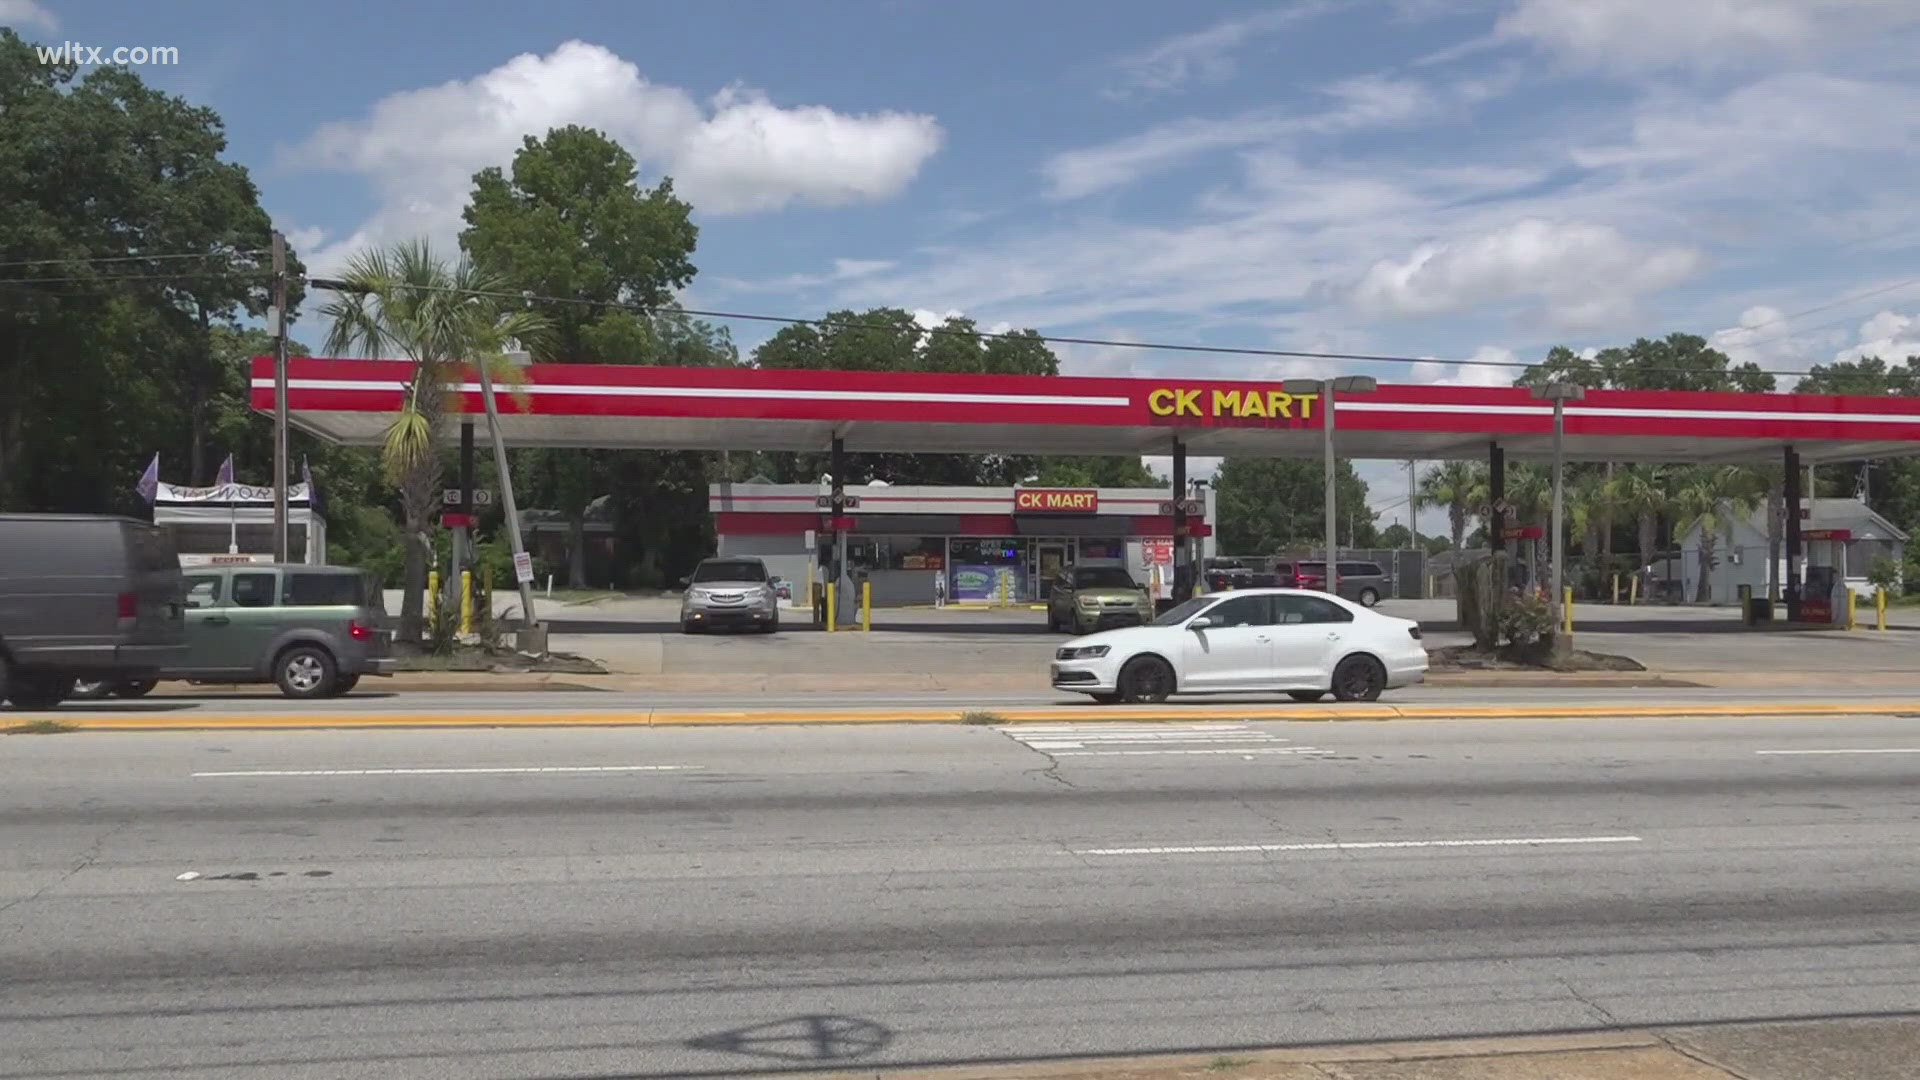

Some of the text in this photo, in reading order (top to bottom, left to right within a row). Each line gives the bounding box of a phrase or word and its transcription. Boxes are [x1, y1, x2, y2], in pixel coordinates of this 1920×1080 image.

[1148, 388, 1318, 418] CK MART
[1019, 494, 1094, 507] CK MART
